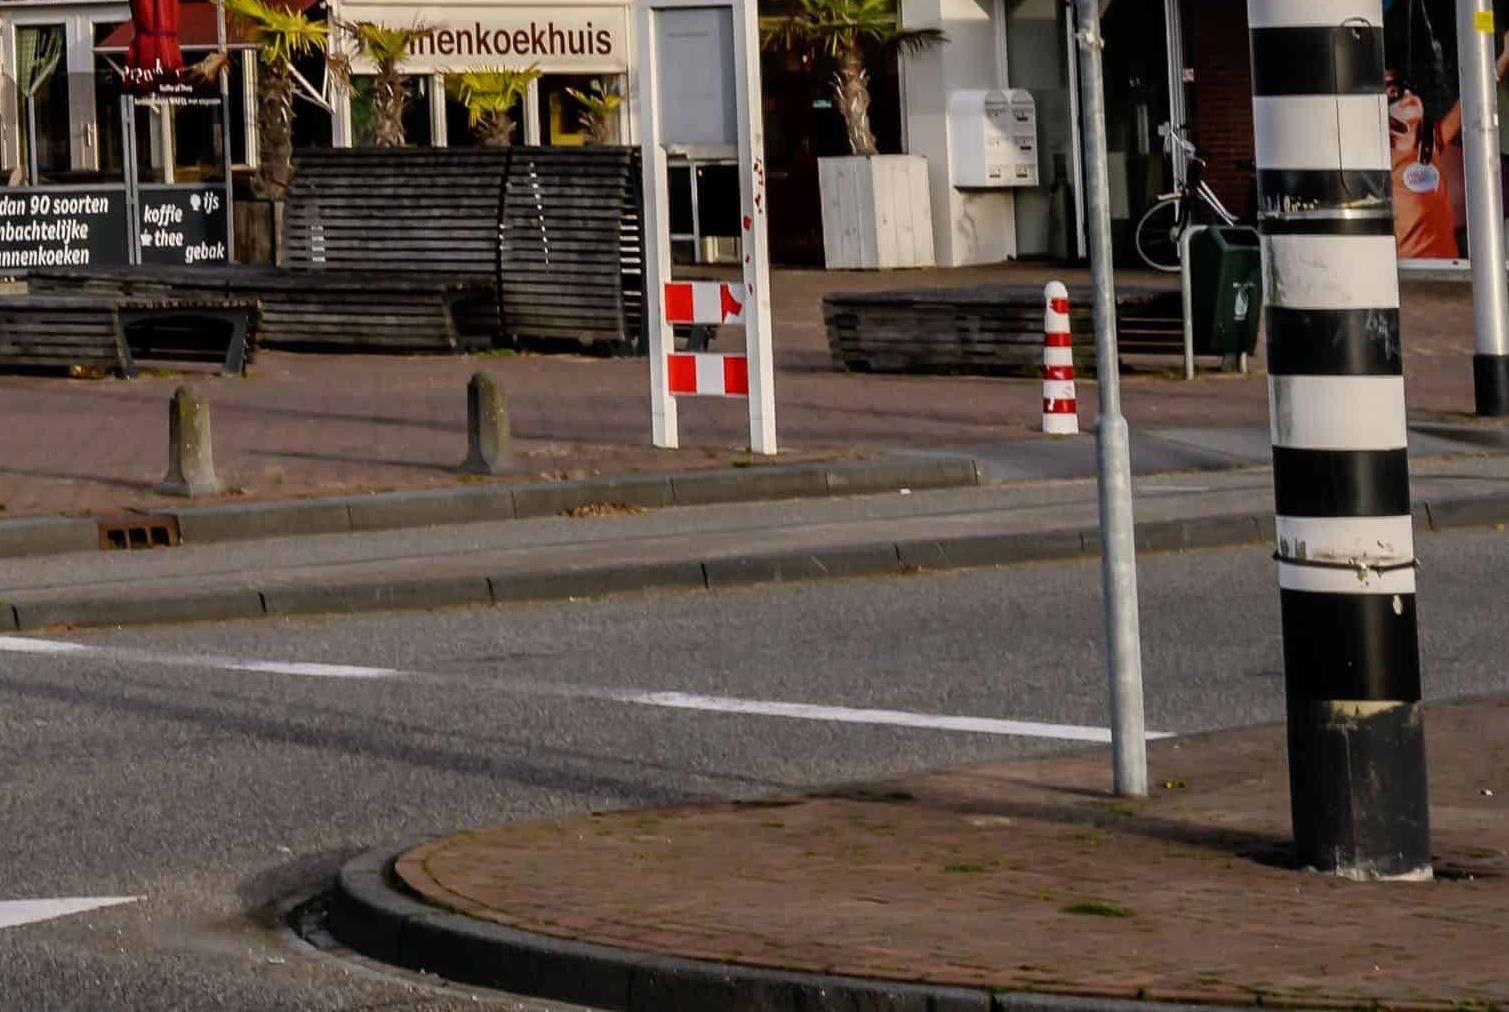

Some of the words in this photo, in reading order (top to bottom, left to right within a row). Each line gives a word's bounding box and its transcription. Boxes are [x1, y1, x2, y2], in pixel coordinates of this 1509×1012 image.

[29, 194, 51, 216] 90
[52, 194, 110, 216] soorten
[144, 203, 184, 227] koffie
[203, 191, 220, 215] ijs
[154, 227, 184, 248] thee
[184, 240, 226, 265] gebak
